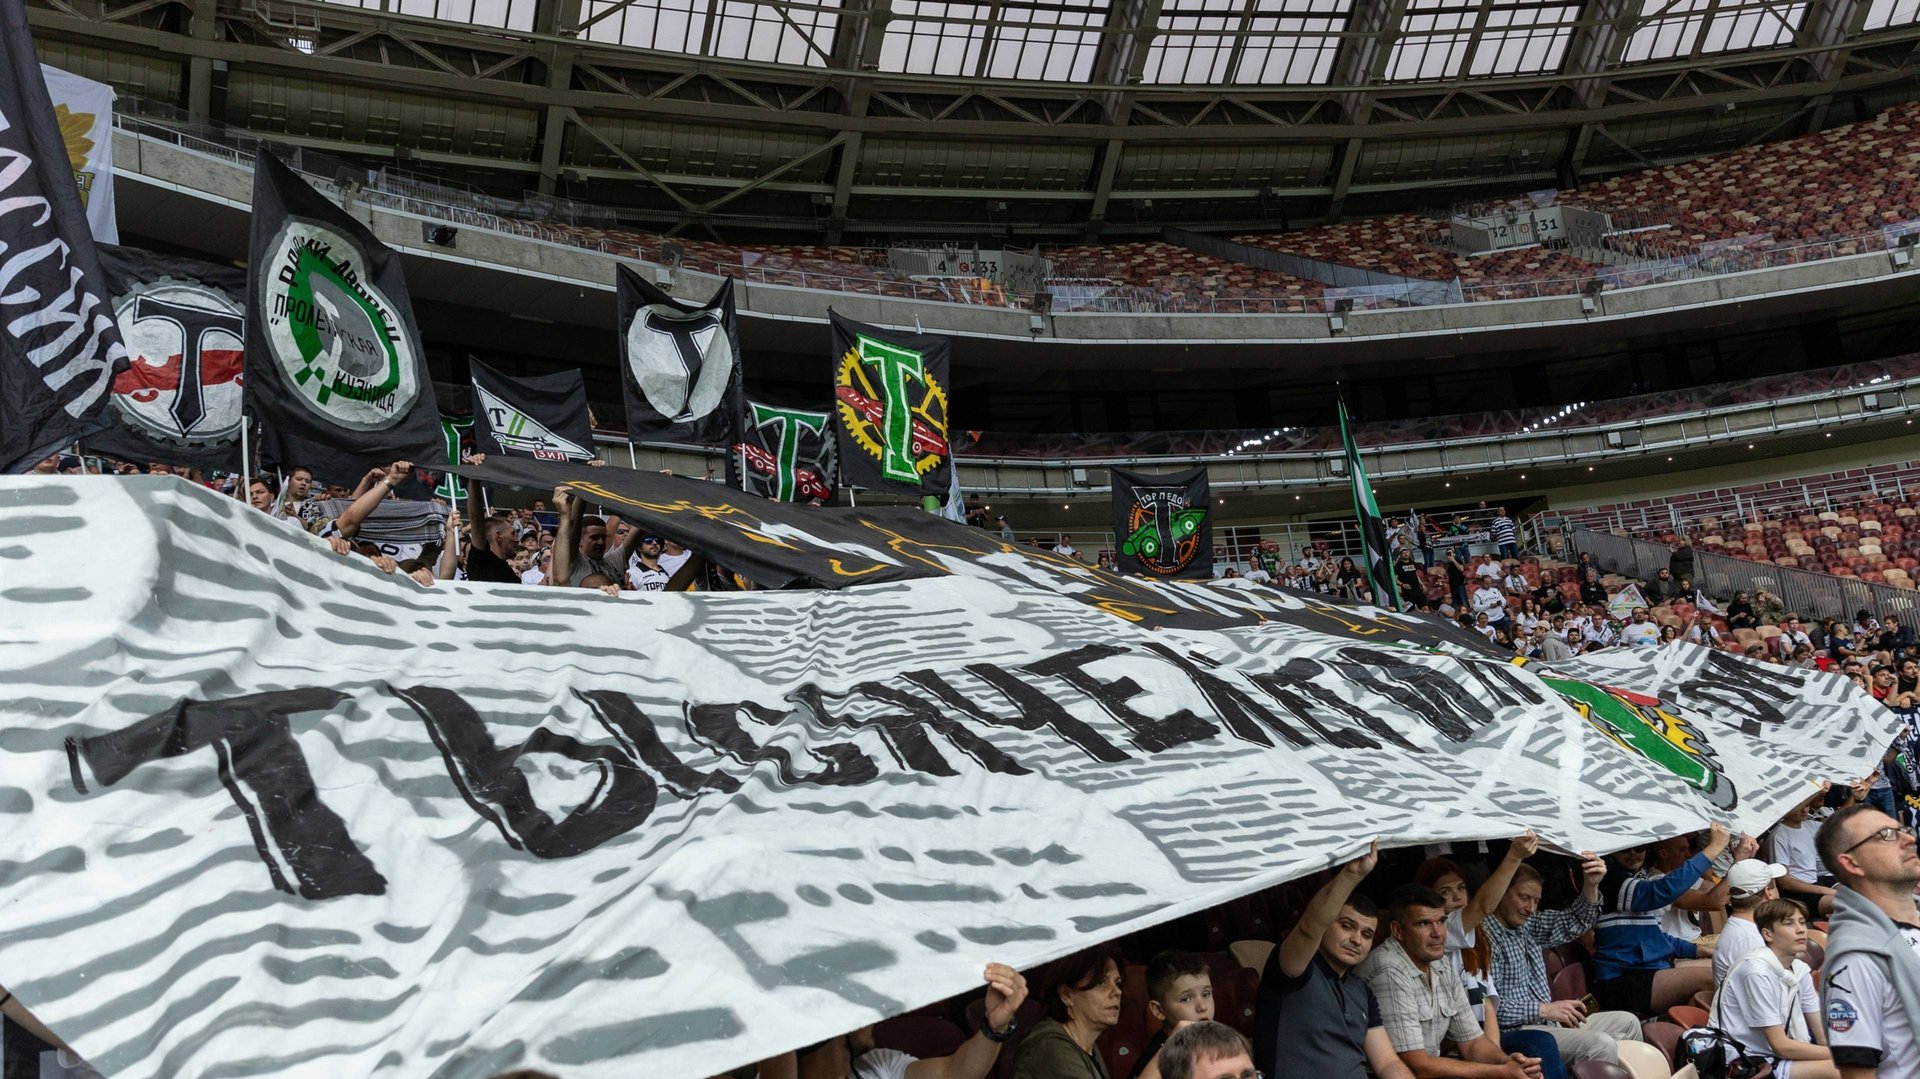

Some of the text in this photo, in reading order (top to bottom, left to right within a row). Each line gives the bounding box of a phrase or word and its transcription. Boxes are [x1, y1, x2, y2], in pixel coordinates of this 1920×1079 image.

[538, 450, 565, 461] ЗИЛ
[1140, 491, 1184, 506] ТОРПЕДО
[643, 582, 667, 591] ТОРП
